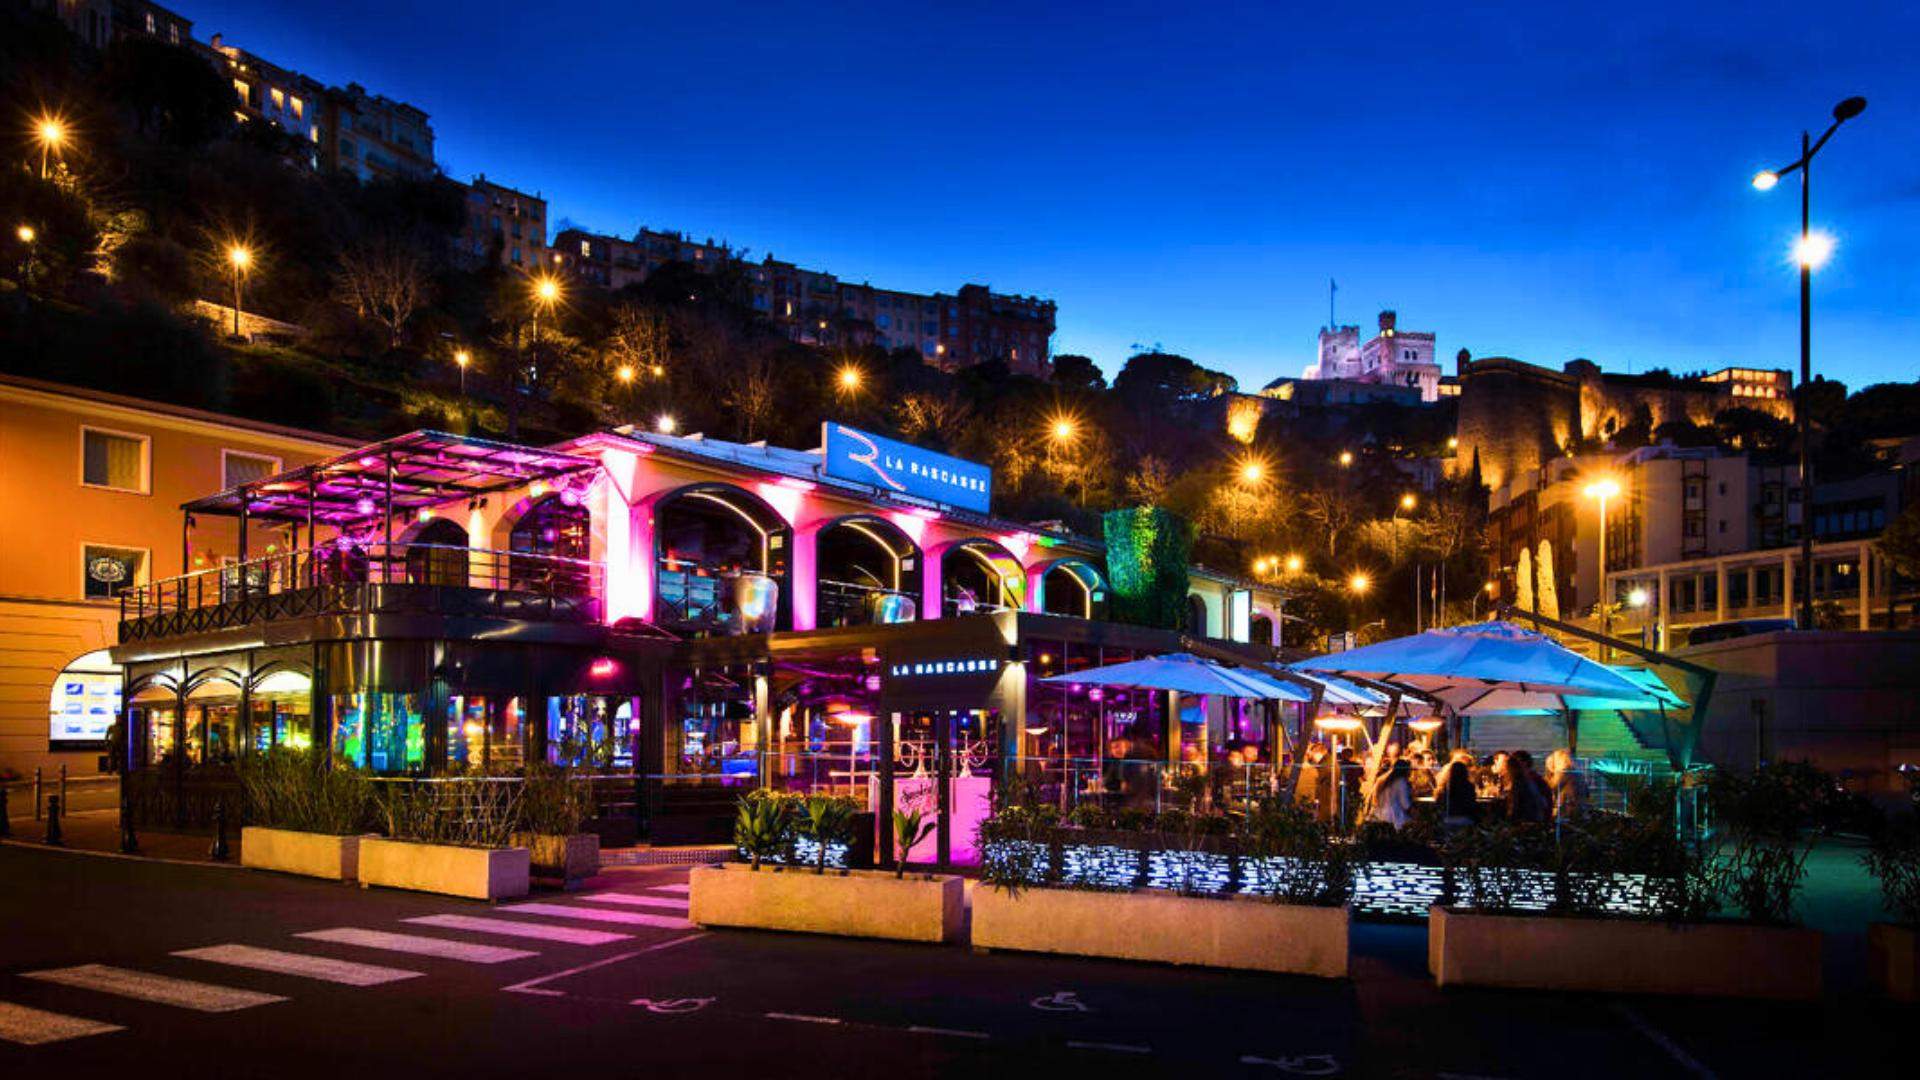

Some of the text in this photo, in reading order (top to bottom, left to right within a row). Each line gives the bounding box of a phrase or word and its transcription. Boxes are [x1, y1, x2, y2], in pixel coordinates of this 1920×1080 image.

[885, 455, 986, 493] LA RASCASSE
[892, 659, 997, 676] LA RASCASSE
